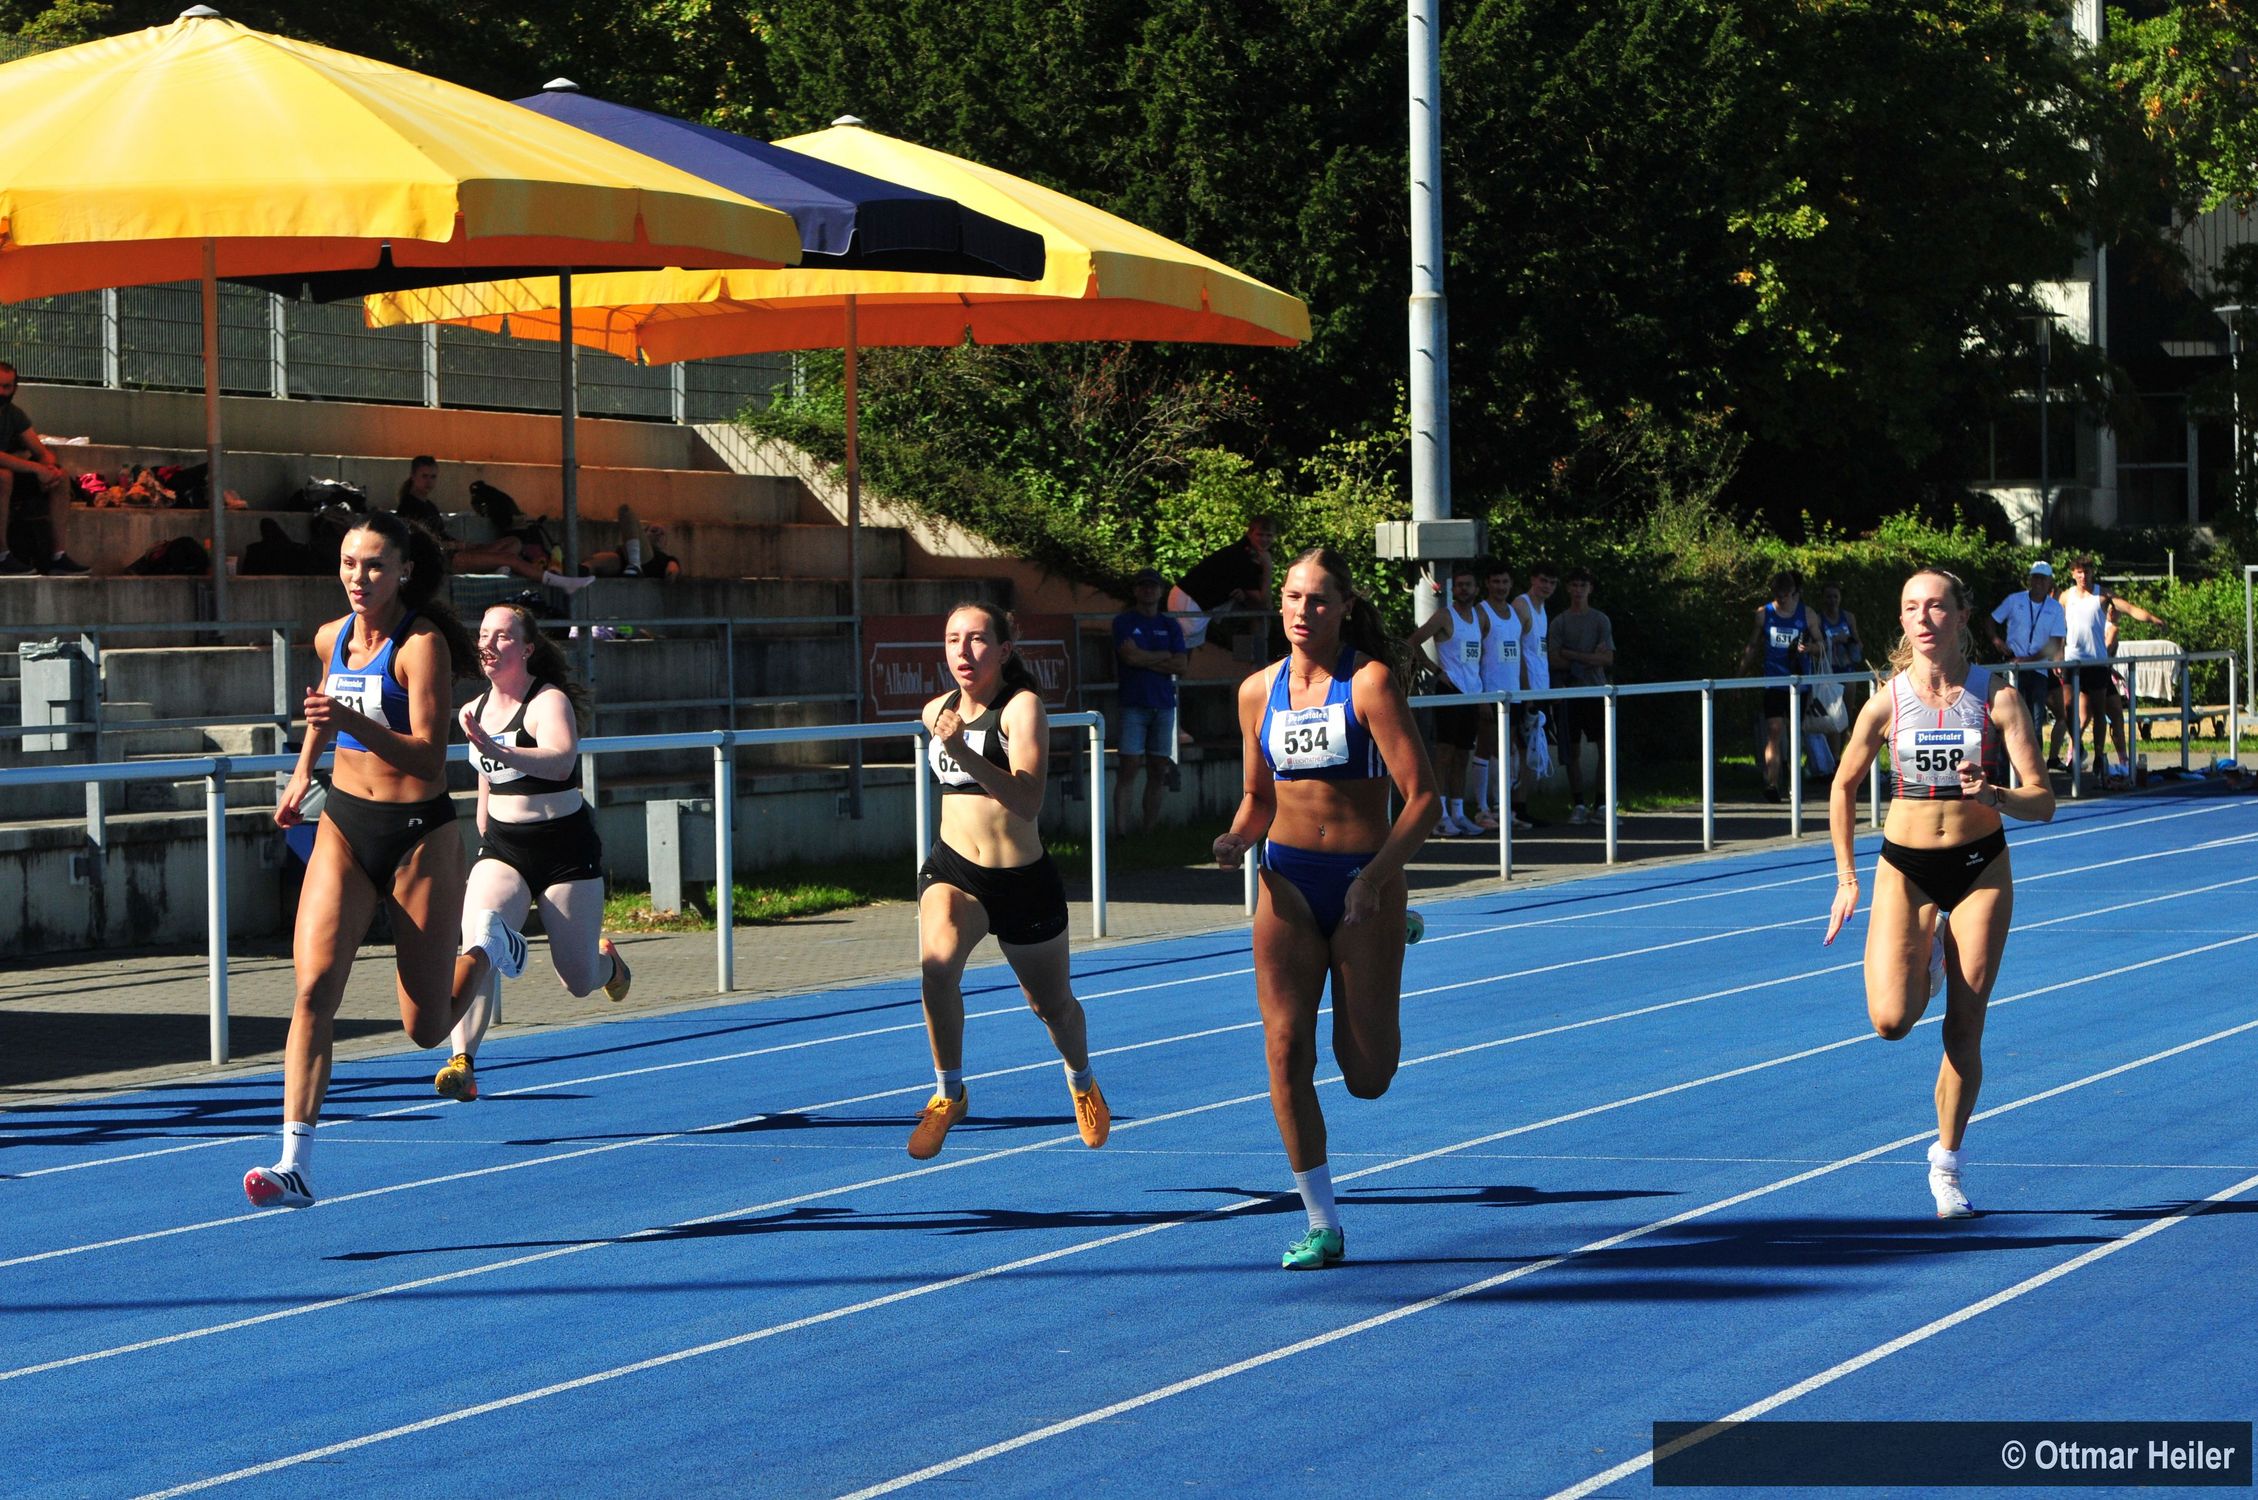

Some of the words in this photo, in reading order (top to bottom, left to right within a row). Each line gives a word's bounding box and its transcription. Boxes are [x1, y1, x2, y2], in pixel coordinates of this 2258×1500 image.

[1284, 727, 1329, 755] 534
[1918, 732, 1961, 743] Peterstaler
[1916, 749, 1964, 771] 558
